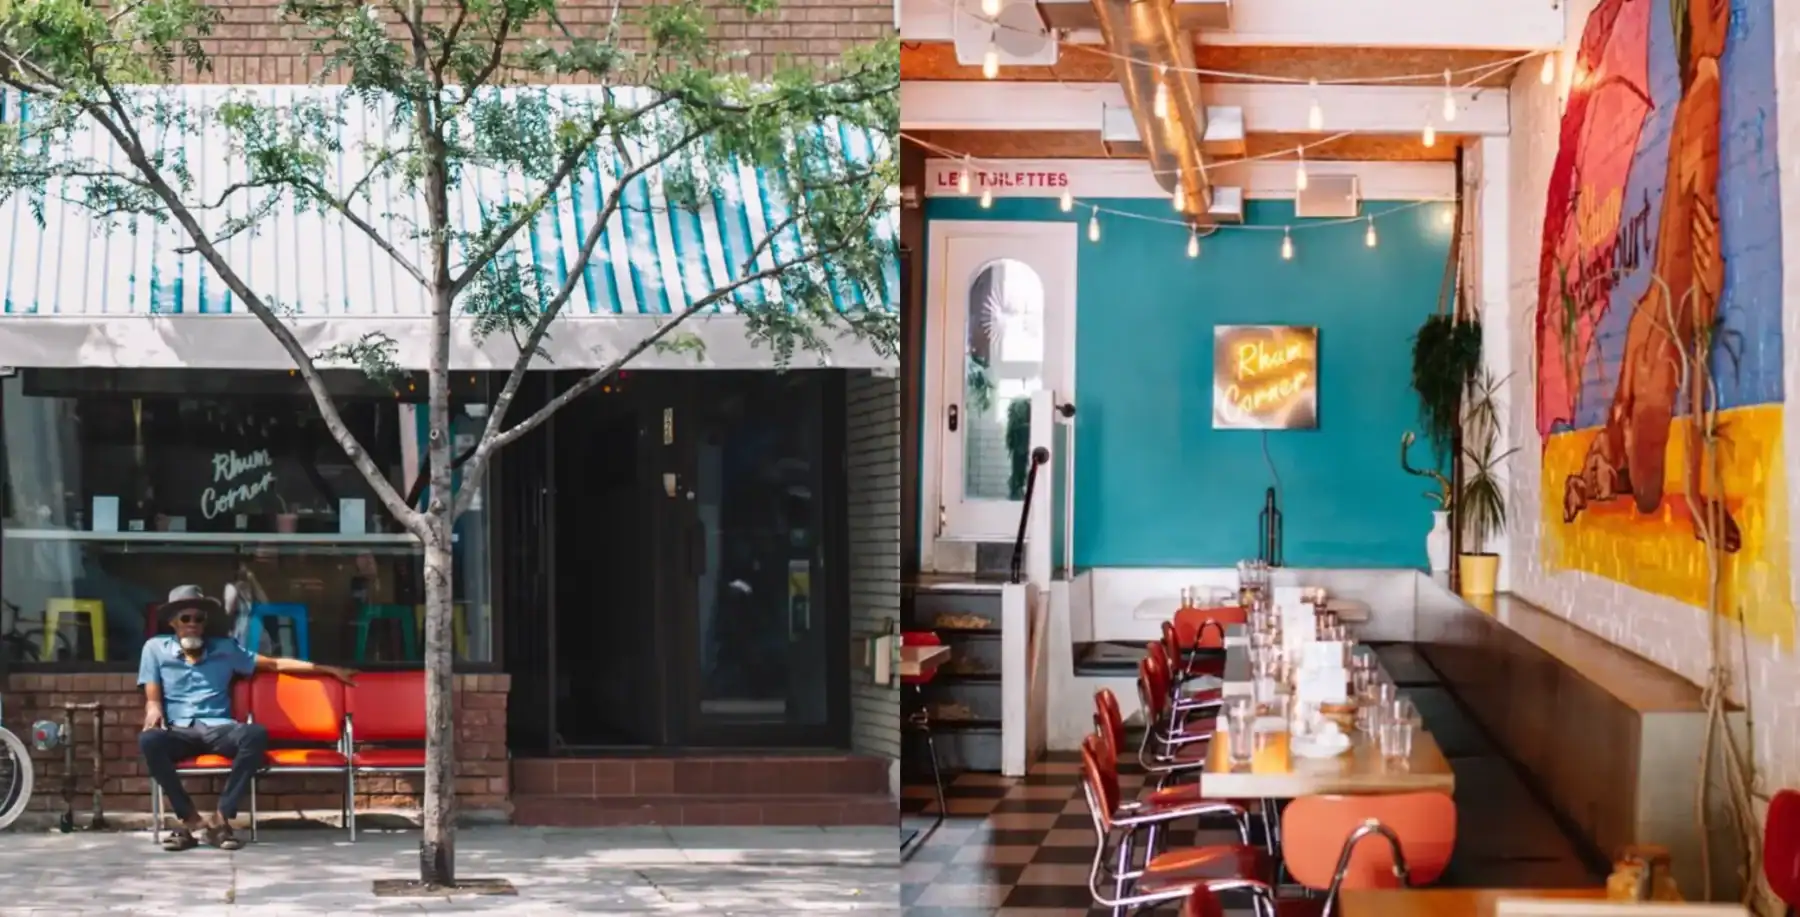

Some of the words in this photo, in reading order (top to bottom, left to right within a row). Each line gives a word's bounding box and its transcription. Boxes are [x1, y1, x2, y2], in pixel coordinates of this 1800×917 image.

[938, 172, 968, 186] LE
[1238, 340, 1304, 381] Rhum
[1222, 371, 1308, 423] Corner
[212, 449, 273, 482] Rhum
[201, 472, 277, 519] Corner
